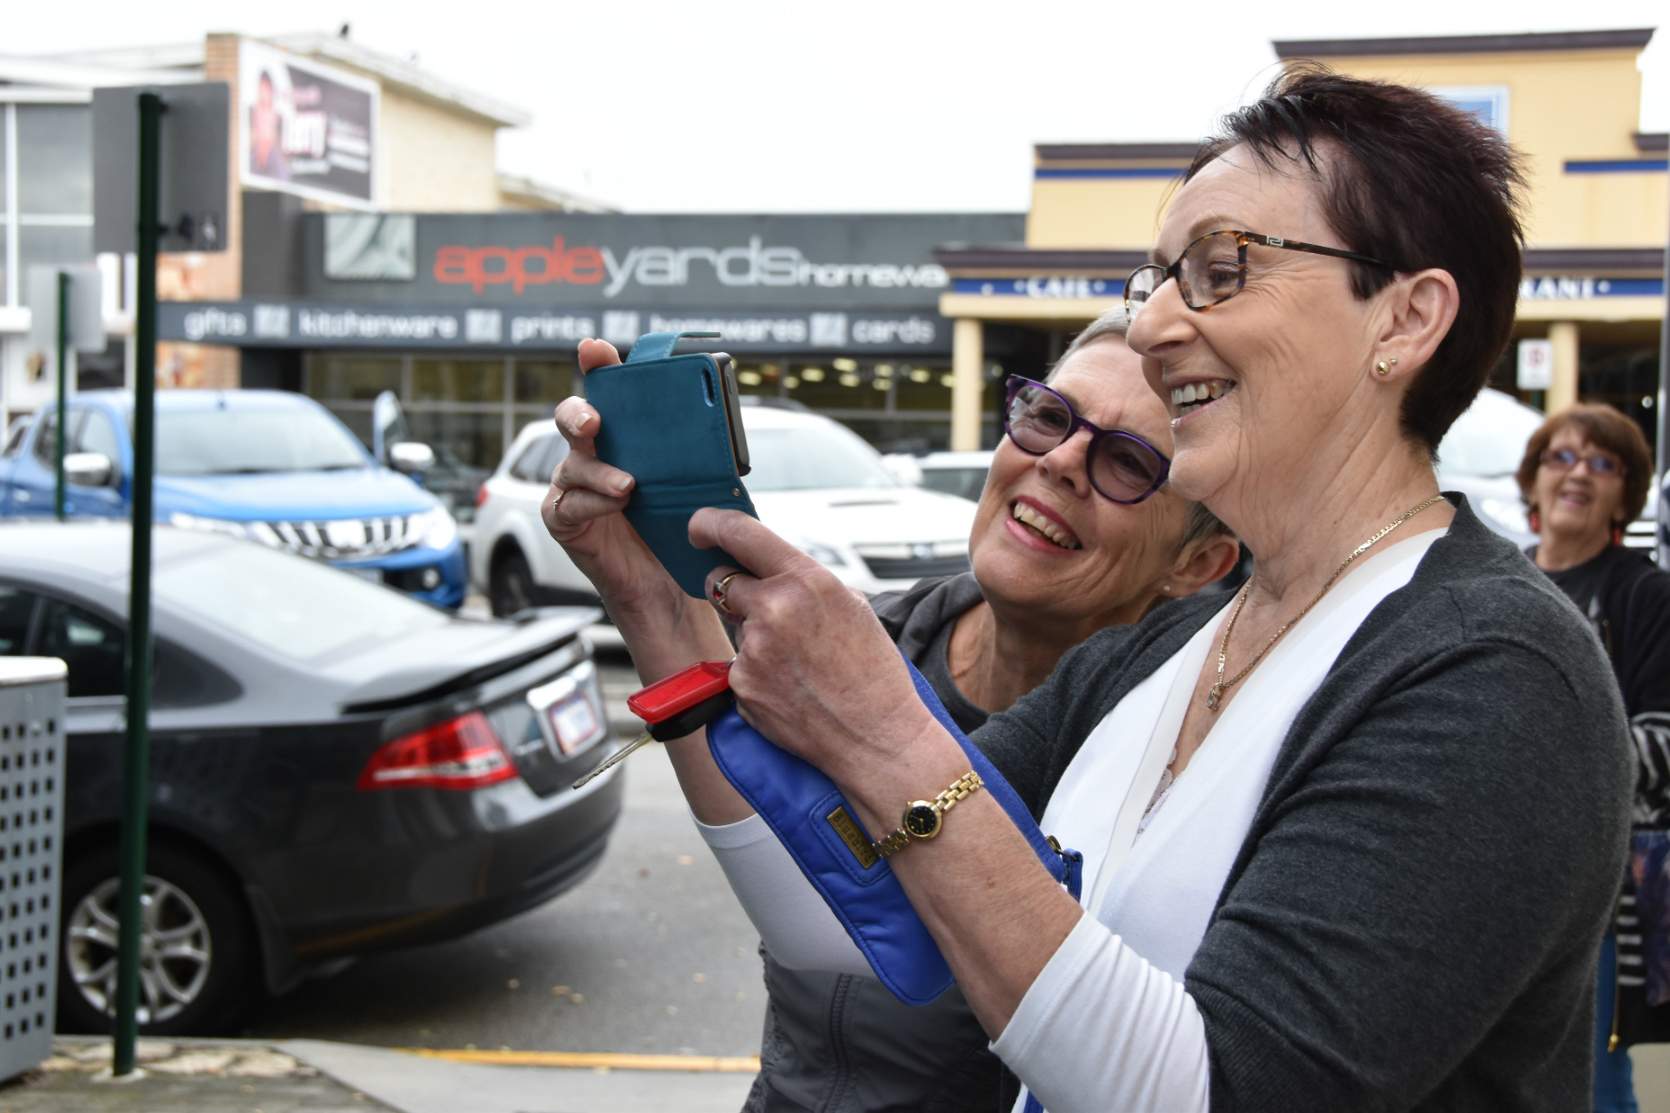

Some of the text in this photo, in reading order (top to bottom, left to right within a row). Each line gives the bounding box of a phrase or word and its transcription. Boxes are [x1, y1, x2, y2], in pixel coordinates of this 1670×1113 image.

[184, 307, 247, 340] gifts
[299, 306, 457, 339] kitchenware
[511, 315, 595, 345] prints
[852, 316, 936, 344] cards
